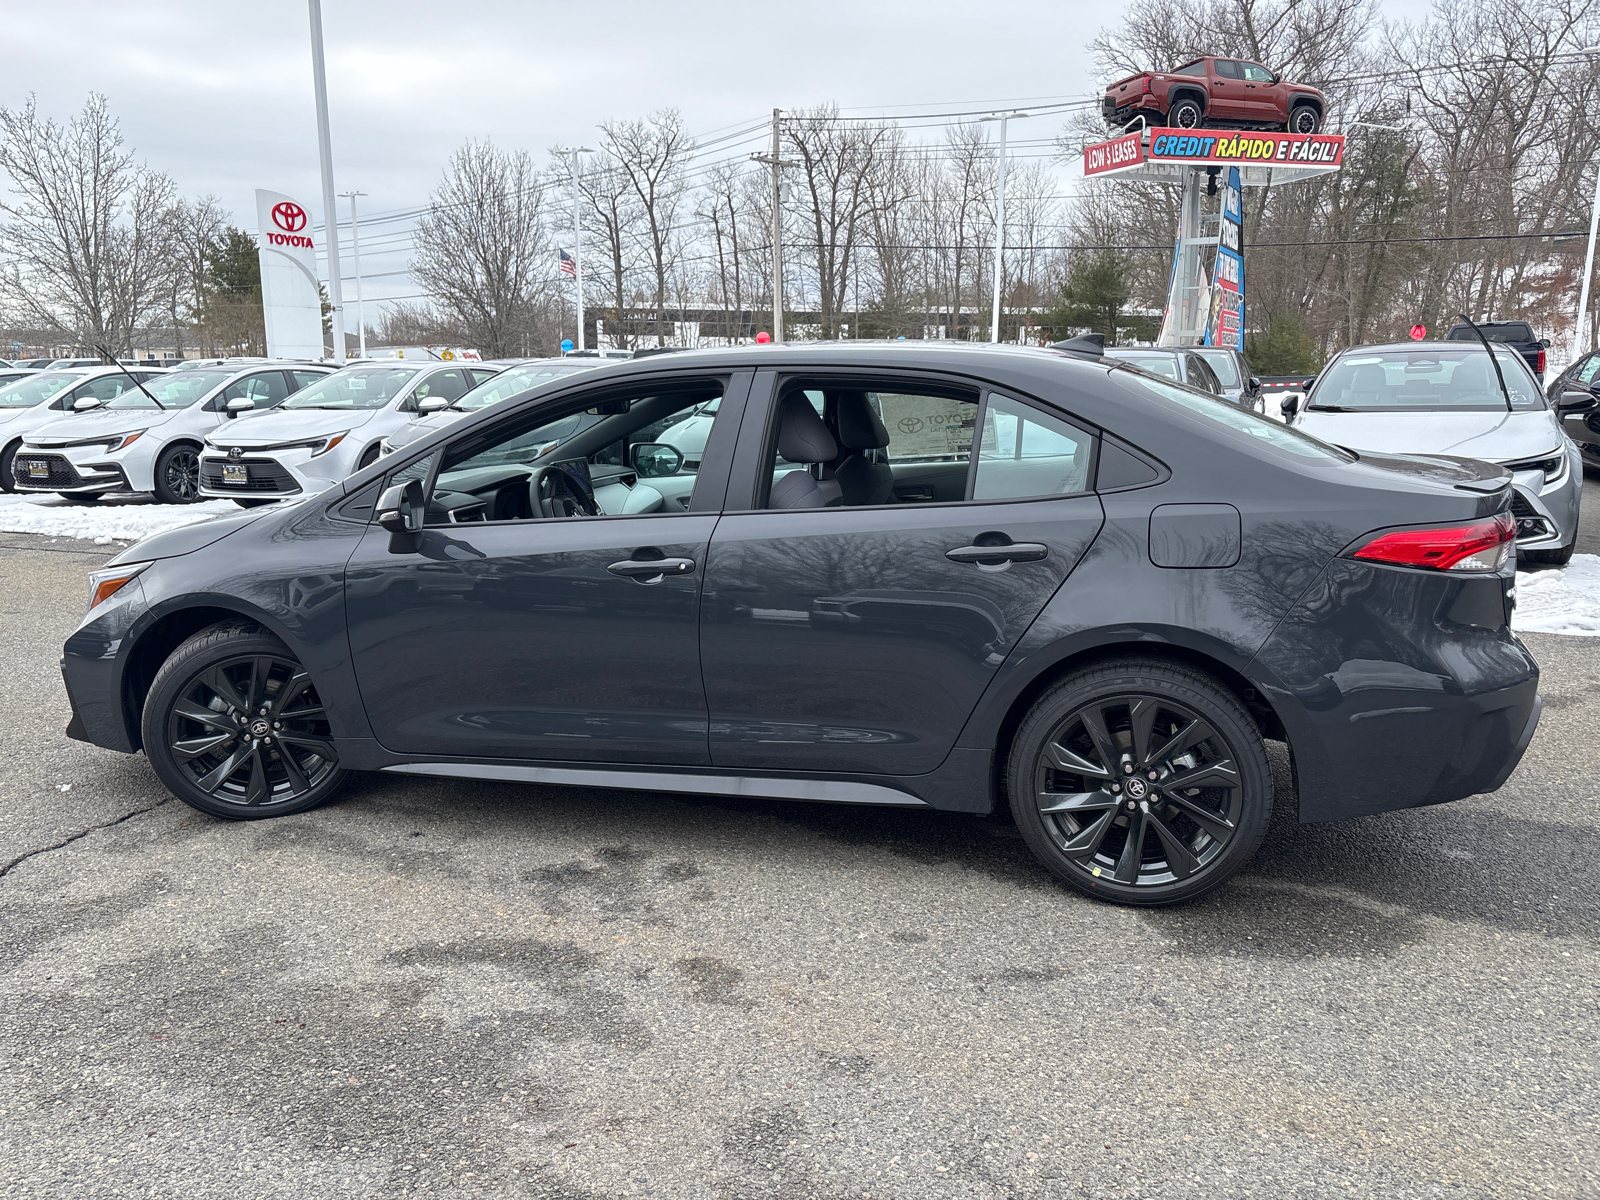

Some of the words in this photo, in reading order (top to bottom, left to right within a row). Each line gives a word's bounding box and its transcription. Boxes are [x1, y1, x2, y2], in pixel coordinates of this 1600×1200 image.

[1088, 147, 1105, 169] LOW
[1111, 139, 1137, 164] LEASES
[1153, 135, 1215, 157] CREDIT
[1215, 134, 1275, 159] RÁPIDO
[1275, 140, 1289, 160] E
[1289, 137, 1339, 161] FÁCIL!
[266, 232, 314, 249] TOYOTA
